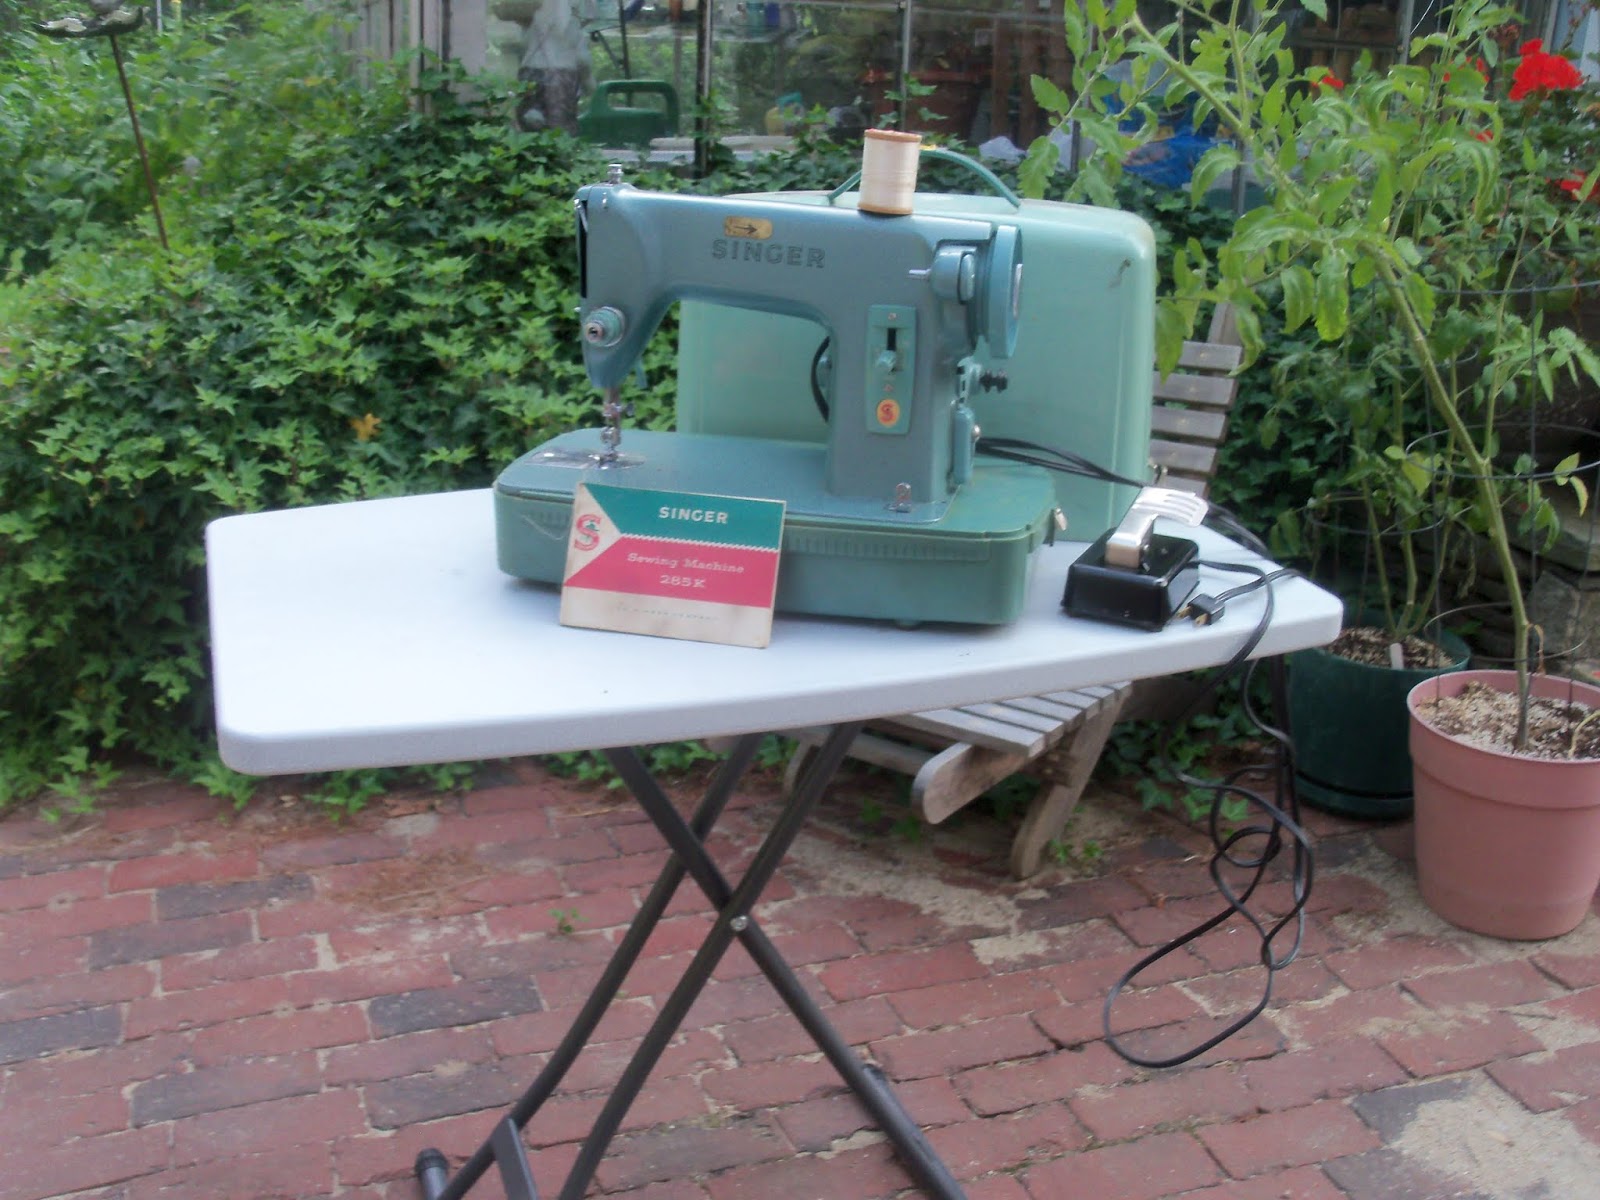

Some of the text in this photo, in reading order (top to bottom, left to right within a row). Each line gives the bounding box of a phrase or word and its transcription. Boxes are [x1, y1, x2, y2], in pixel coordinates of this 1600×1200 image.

[711, 239, 826, 269] SINGER
[880, 403, 895, 424] S
[658, 506, 729, 524] SINGER
[627, 552, 745, 573] Sewing Machine
